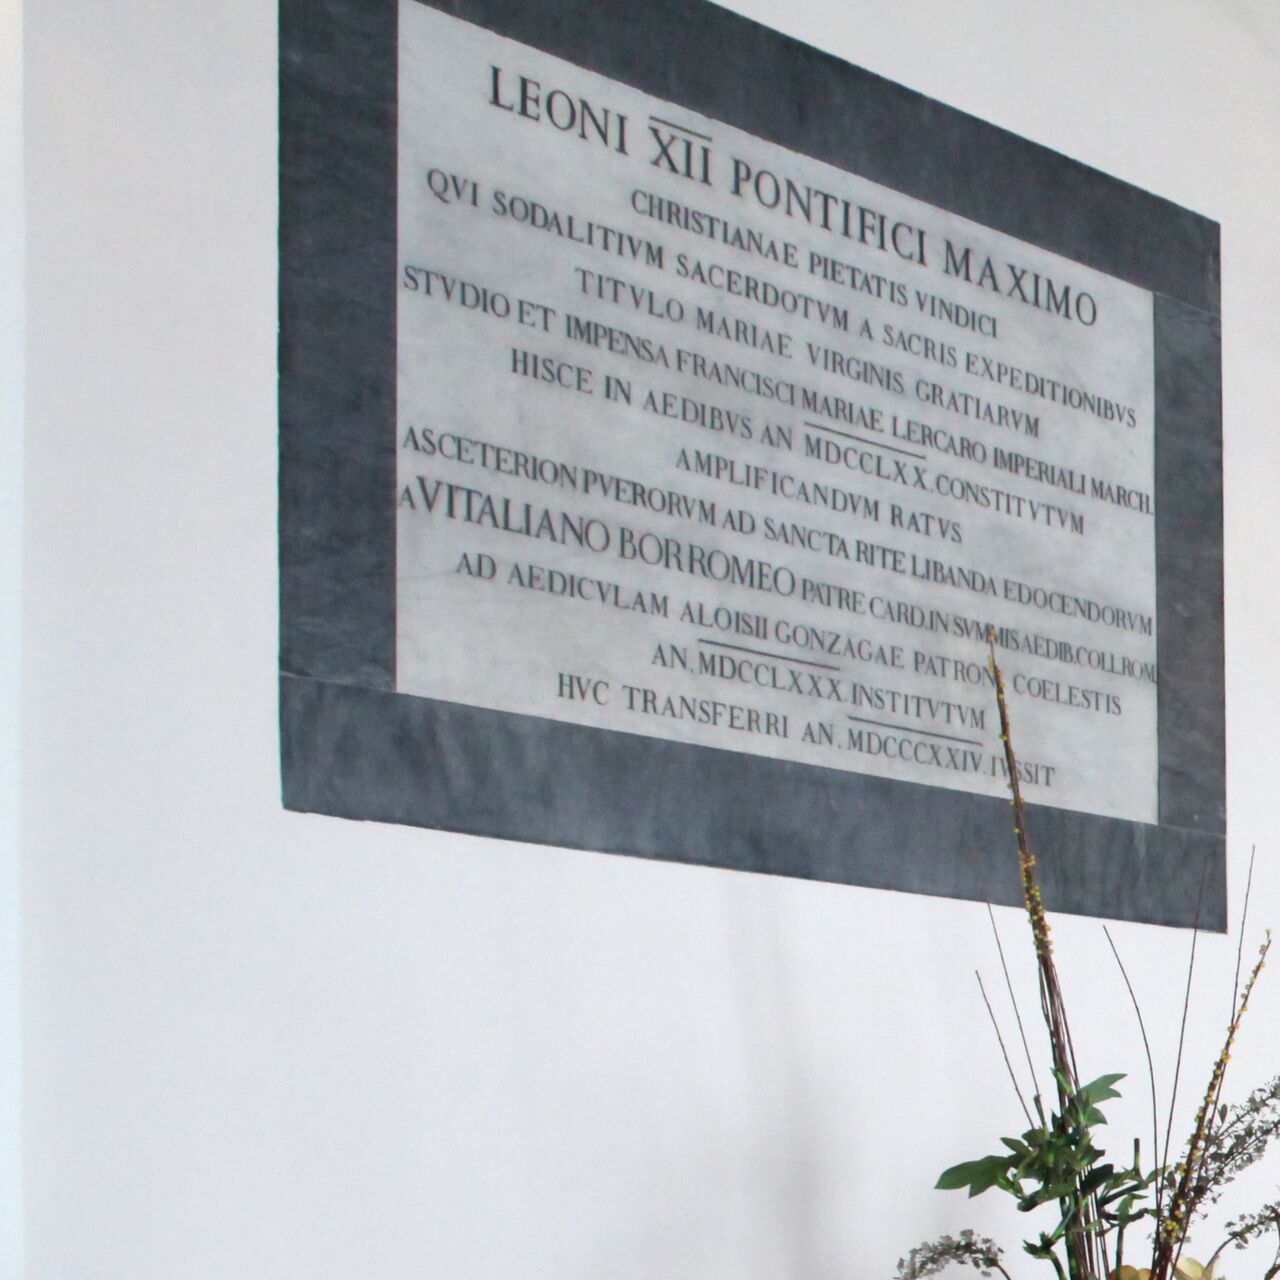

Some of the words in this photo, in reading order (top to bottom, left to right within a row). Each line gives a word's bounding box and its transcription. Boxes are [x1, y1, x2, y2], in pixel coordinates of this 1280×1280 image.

[489, 65, 628, 156] LEONI
[649, 116, 713, 187] XII
[731, 156, 928, 268] PONTIFICI
[943, 239, 1098, 327] MAXIMO
[631, 190, 799, 269] CHRISTIANAE
[808, 251, 908, 306] PIETATIS
[915, 290, 998, 338] VINDICI
[403, 265, 510, 318] STVDIO
[517, 299, 556, 332] ET
[565, 314, 669, 368] IMPENSA
[676, 348, 795, 406] FRANCISCI
[802, 388, 884, 433] MARIAE
[892, 416, 987, 463] LERCARO
[993, 448, 1085, 496] IMPERIALI
[427, 168, 479, 207] QVI
[493, 191, 664, 270] SODALITIVM
[676, 254, 848, 331] SACERDOTVM
[859, 318, 873, 340] A
[883, 324, 957, 369] SACRIS
[966, 352, 1137, 428] EXPEDITIONIBVS
[575, 267, 684, 322] TITVLO
[696, 307, 792, 359] MARIAE
[807, 343, 904, 394] VIRGINIS
[916, 378, 1039, 438] GRATIARVM
[511, 348, 592, 395] HISCE
[604, 376, 632, 405] IN
[643, 390, 752, 439] AEDIBVS
[760, 425, 792, 451] AN
[936, 474, 1084, 535] CONSTITVTVM
[676, 448, 879, 522] AMPLIFICANDVM
[890, 505, 962, 543] RATVS
[402, 425, 577, 489] ASCETERION
[582, 469, 716, 526] PVERORVM
[722, 506, 755, 534] AD
[764, 517, 849, 559] SANCTA
[855, 540, 906, 574] RITE
[911, 555, 997, 597] LIBANDA
[1003, 579, 1152, 637] EDOCENDORVM
[618, 527, 796, 598] BORROMEO
[801, 579, 864, 614] PATRE
[456, 552, 497, 580] AD
[507, 562, 668, 617] AEDICVLAM
[680, 602, 768, 640] ALOISII
[775, 620, 904, 669] GONZAGAE
[913, 651, 1000, 689] PATRON
[1013, 674, 1122, 716] COELESTIS
[557, 673, 609, 705] HVC
[622, 685, 788, 738] TRANSFERRI
[851, 683, 985, 730] INSTITVTVM
